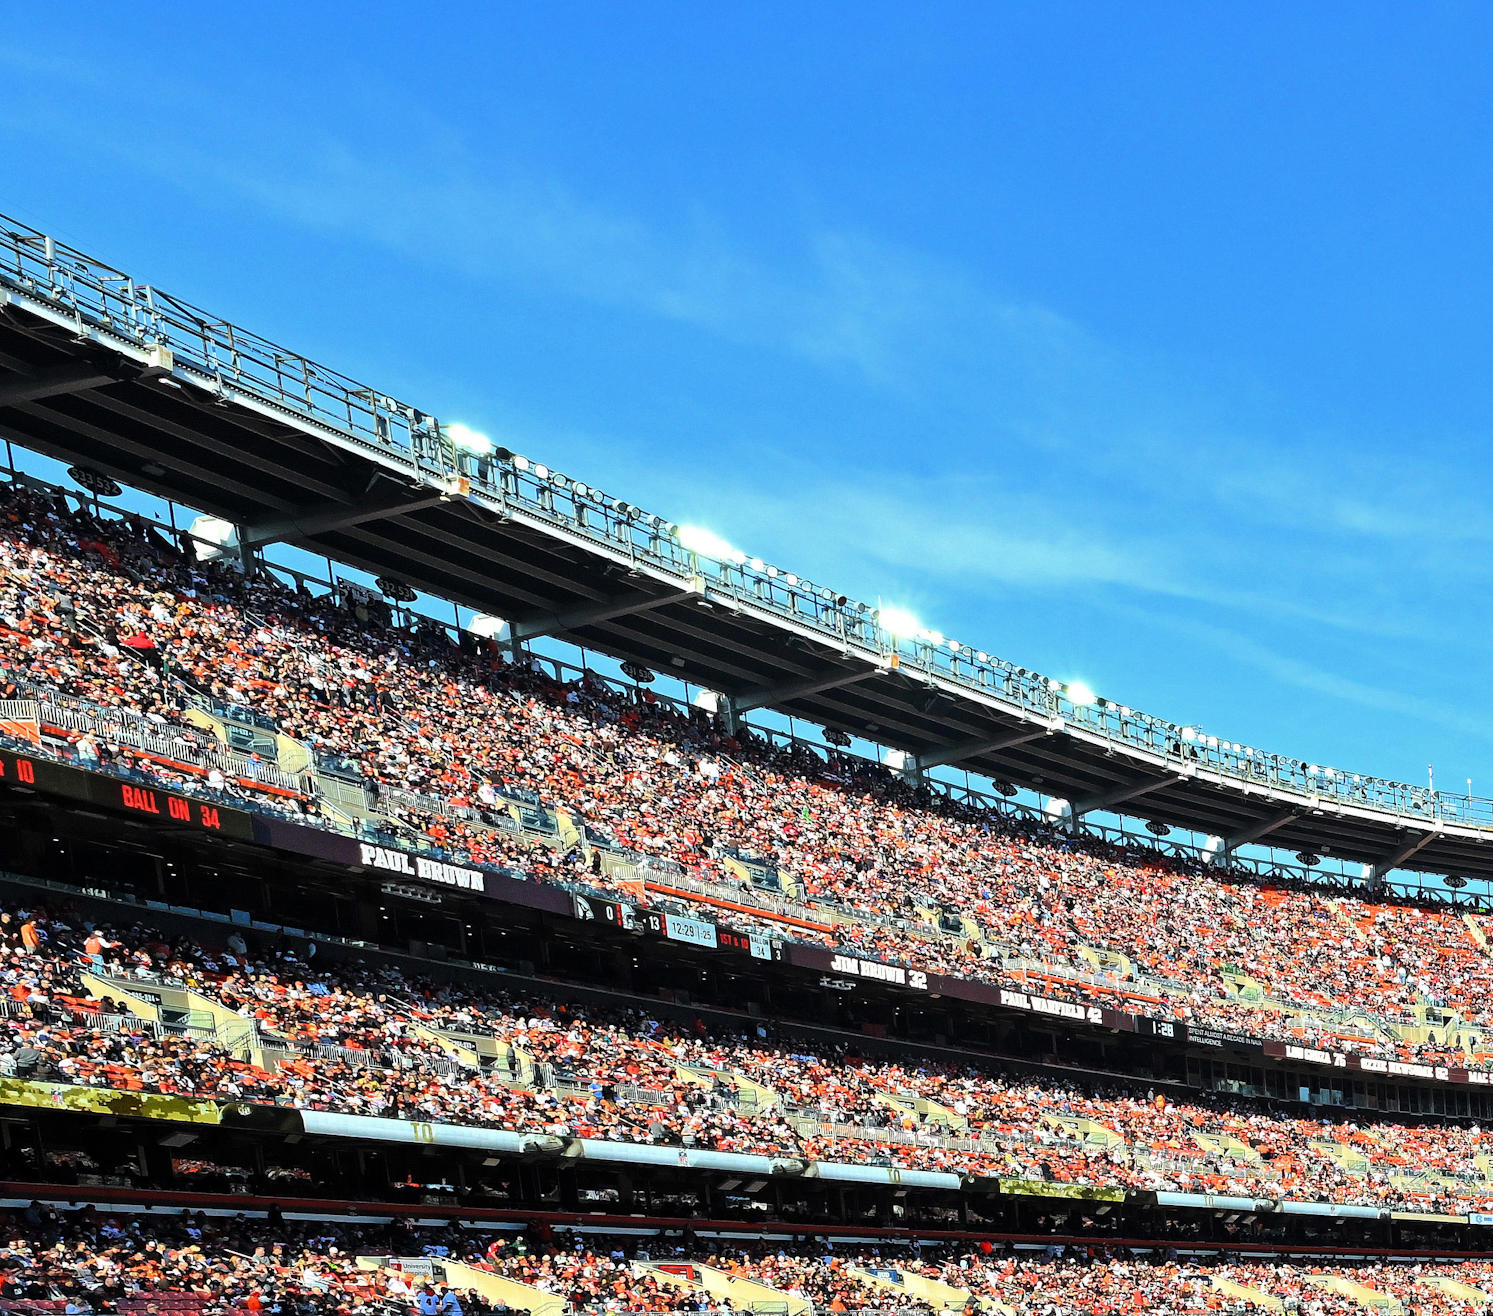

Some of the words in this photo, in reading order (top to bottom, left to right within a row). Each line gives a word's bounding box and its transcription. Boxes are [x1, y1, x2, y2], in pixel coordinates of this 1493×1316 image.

[16, 759, 35, 784] 10
[122, 785, 160, 815] BALL
[169, 796, 190, 821] ON
[201, 805, 221, 829] 34
[360, 843, 416, 876] PAUL
[416, 857, 485, 892] BROWN
[606, 906, 614, 920] 0
[649, 916, 661, 930] 13
[671, 922, 695, 937] 12:29
[831, 955, 859, 975] JIM
[860, 959, 906, 984] BROWN
[908, 969, 928, 990] 32
[411, 1120, 433, 1142] TO
[403, 1263, 431, 1271] University
